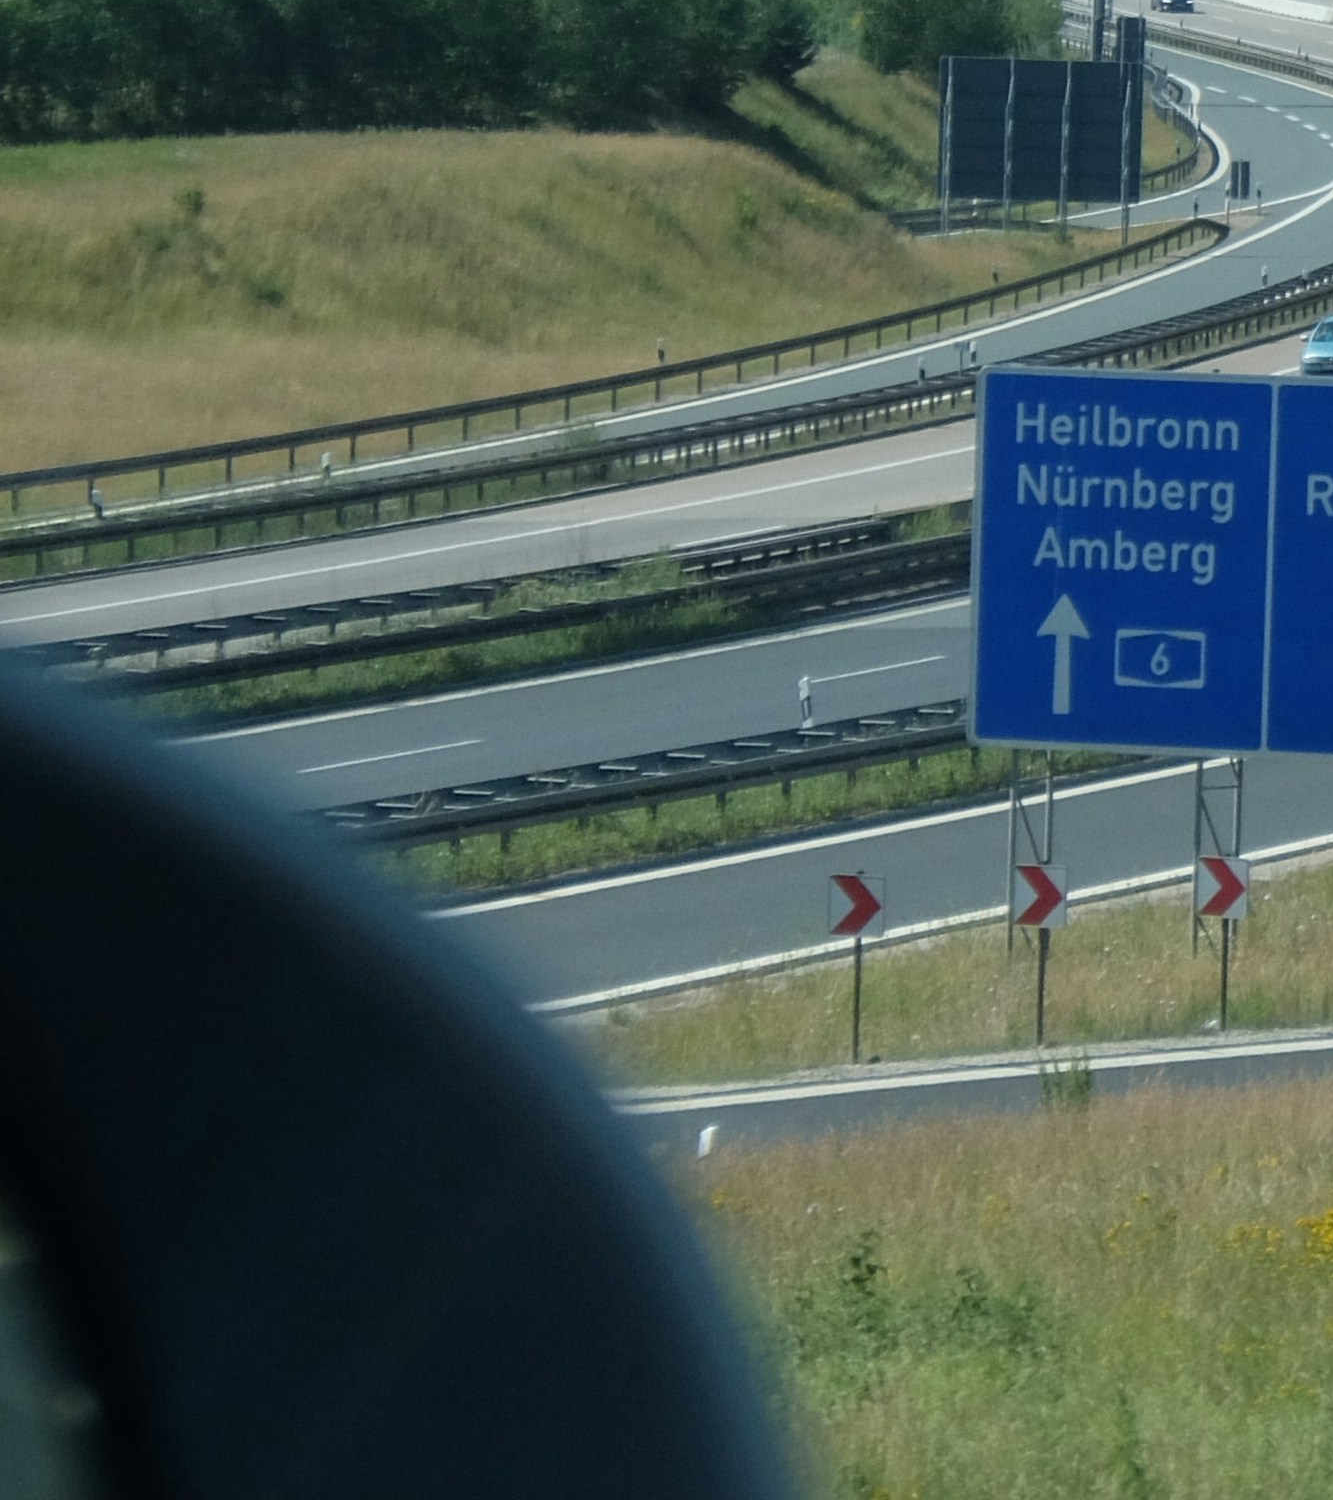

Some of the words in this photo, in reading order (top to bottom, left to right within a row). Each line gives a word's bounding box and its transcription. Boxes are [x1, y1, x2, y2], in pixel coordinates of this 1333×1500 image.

[1015, 402, 1240, 452] Heilbronn
[1017, 463, 1235, 525] Nürnberg
[1033, 526, 1216, 586] Amberg
[1150, 642, 1170, 676] 6
